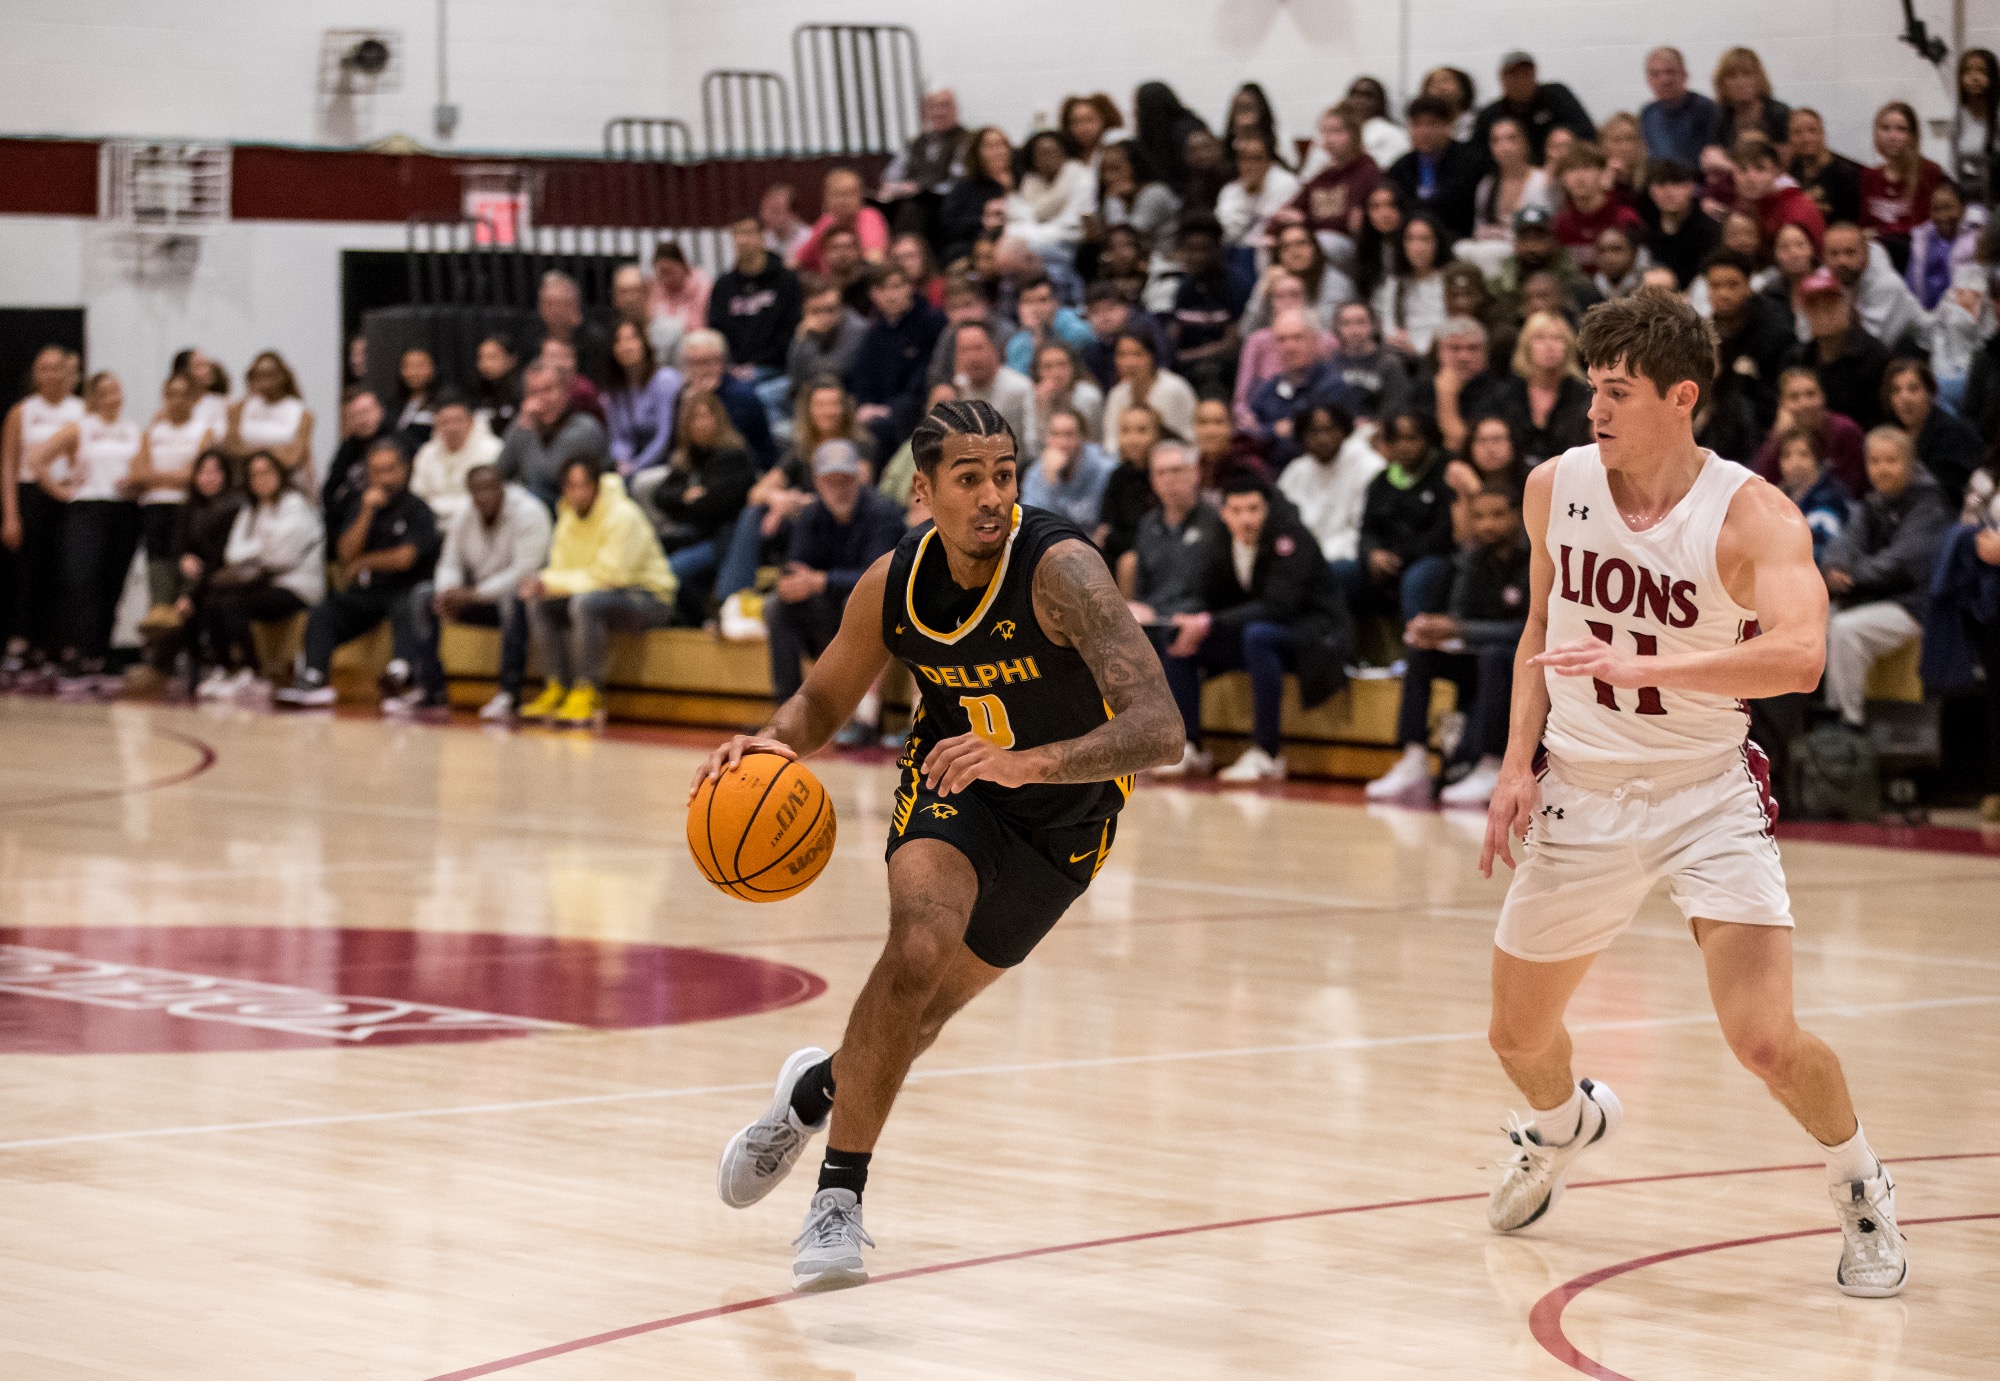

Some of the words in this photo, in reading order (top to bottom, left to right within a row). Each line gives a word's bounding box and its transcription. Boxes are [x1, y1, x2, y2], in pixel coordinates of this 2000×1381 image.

[1561, 544, 1699, 628] LIONS
[917, 656, 1042, 688] DELPHI
[1585, 620, 1667, 715] 11
[775, 778, 811, 832] EVO
[771, 831, 784, 848] NXT
